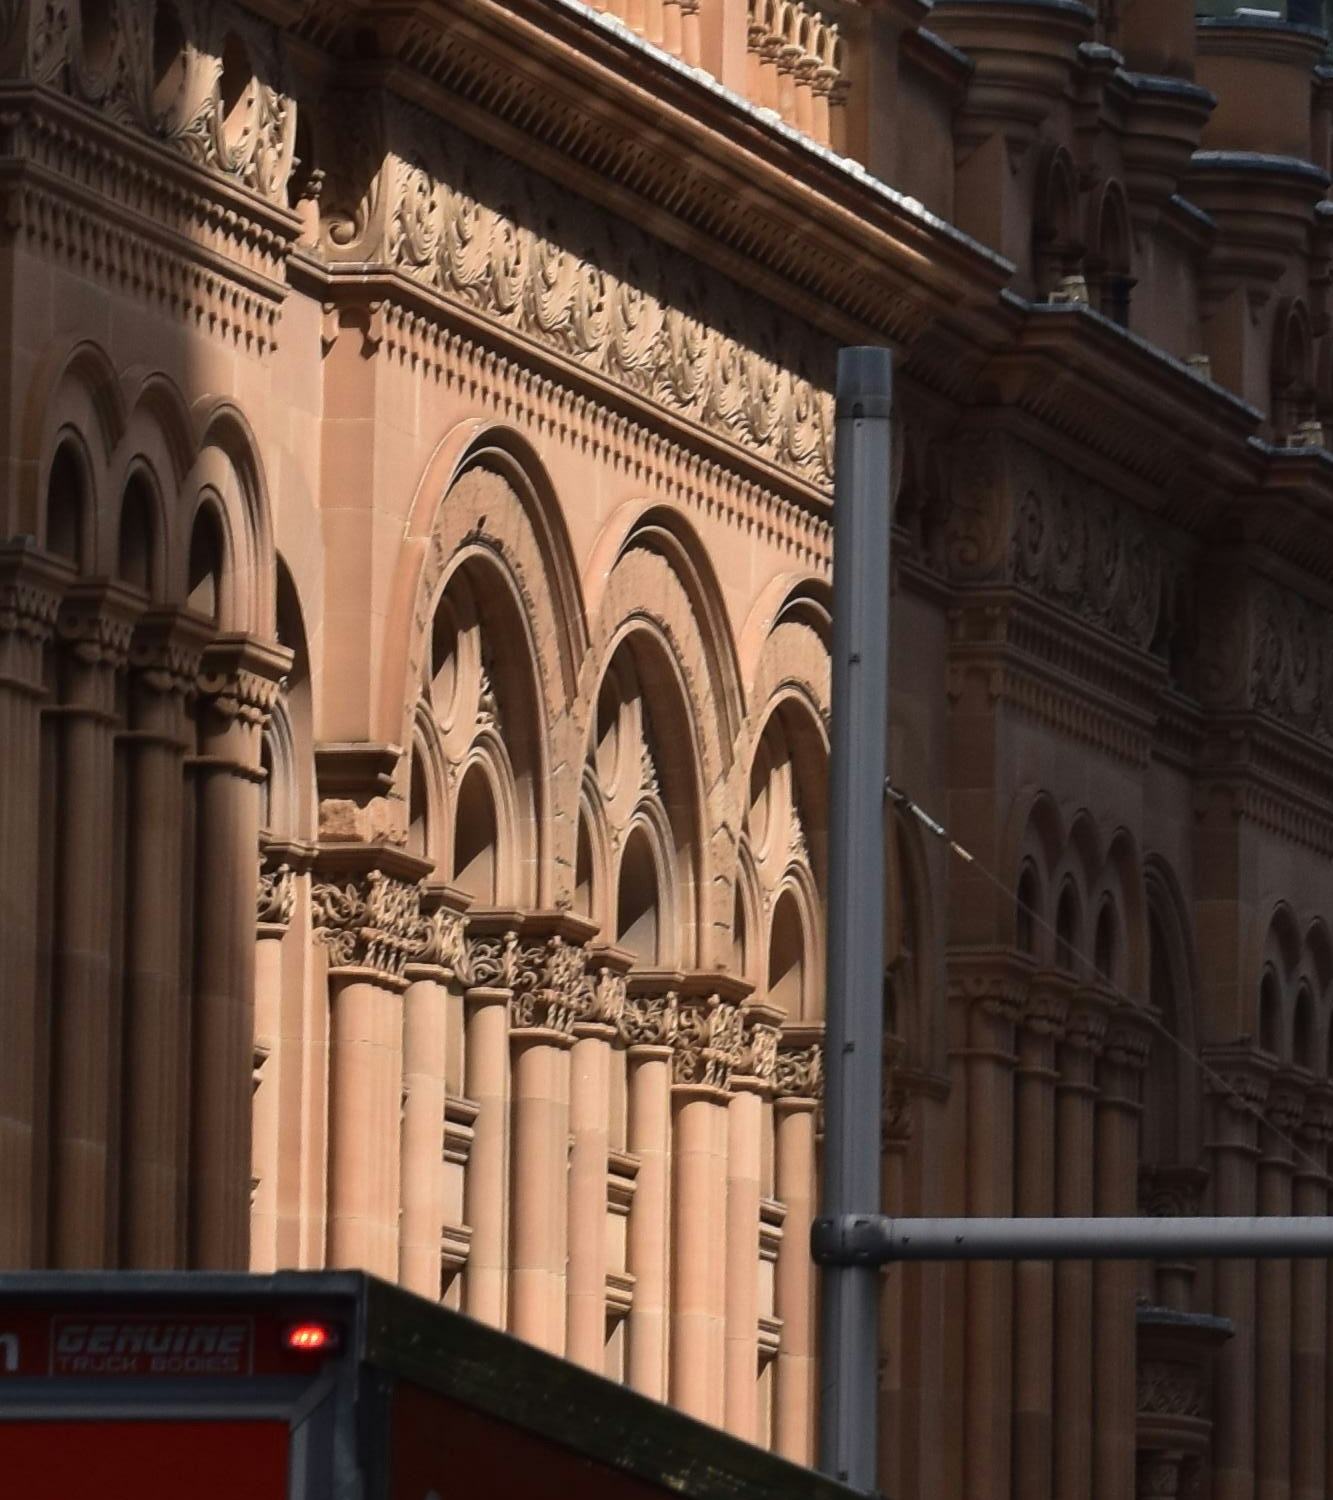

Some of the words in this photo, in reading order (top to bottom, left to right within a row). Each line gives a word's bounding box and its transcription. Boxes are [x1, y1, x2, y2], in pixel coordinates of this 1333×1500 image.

[57, 1324, 247, 1353] GENUINE
[57, 1355, 137, 1372] TRUCK
[151, 1355, 240, 1372] BODIES
